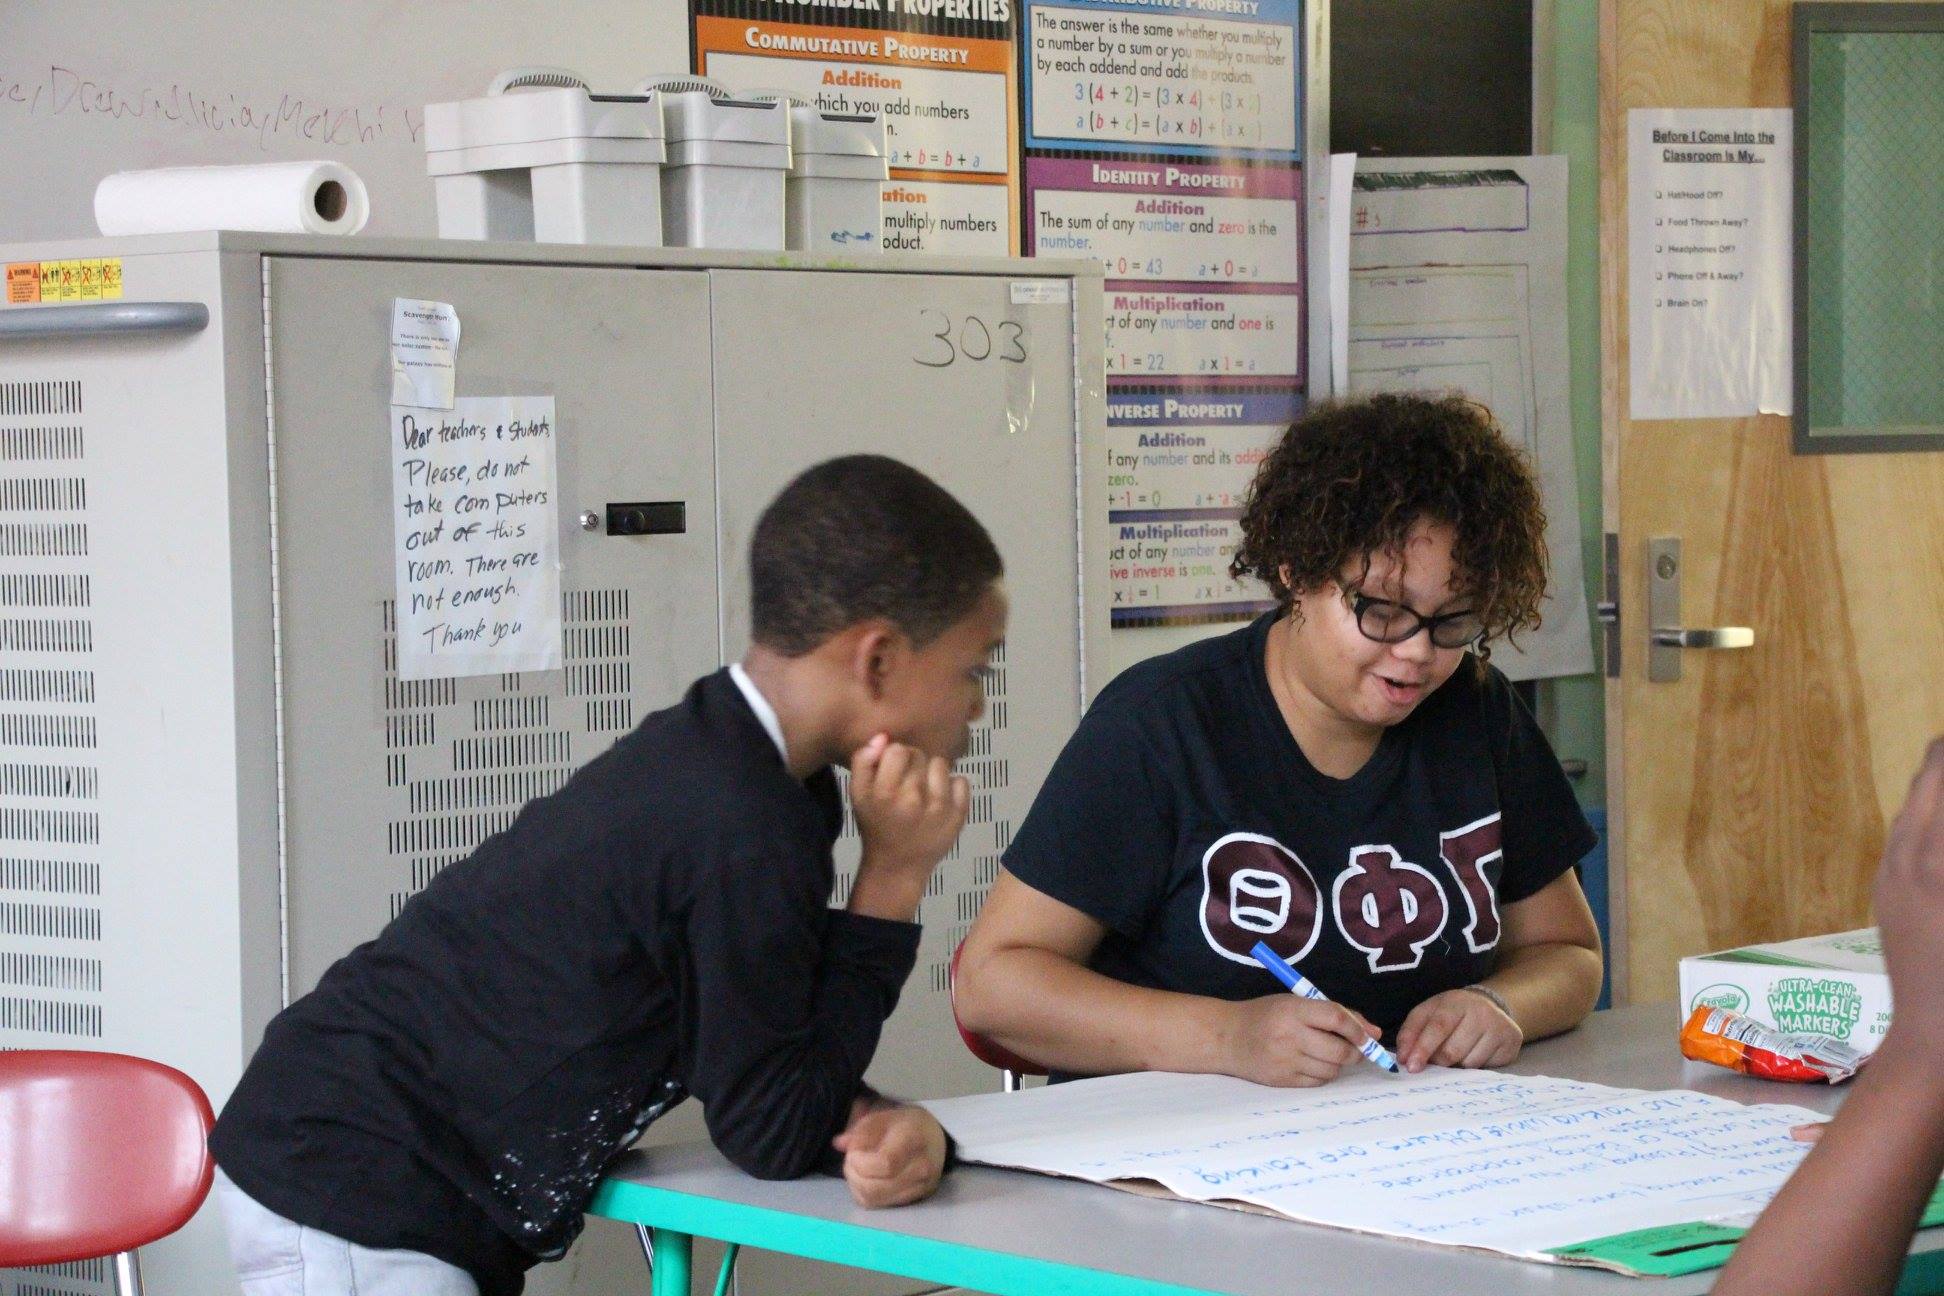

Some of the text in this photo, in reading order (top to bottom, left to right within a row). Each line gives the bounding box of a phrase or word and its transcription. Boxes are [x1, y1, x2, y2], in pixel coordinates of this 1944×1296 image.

[1036, 13, 1283, 49] The answer is the same whether you multiply
[745, 27, 970, 64] COMMUTATIVE PROPERTY
[1037, 38, 1045, 49] a
[1048, 36, 1095, 53] number
[1098, 38, 1112, 56] by
[1118, 43, 1125, 54] a
[1130, 44, 1151, 56] sum
[1155, 45, 1167, 57] or
[1171, 47, 1191, 62] you
[822, 69, 901, 90] Addition
[1037, 58, 1051, 75] by
[1055, 58, 1085, 74] each
[1090, 59, 1137, 77] addend
[1141, 61, 1161, 78] and
[1166, 62, 1188, 79] add
[814, 91, 970, 120] hich you add numbers
[1653, 130, 1688, 143] Before
[1699, 131, 1729, 143] Come
[1734, 131, 1754, 143] Into
[1758, 132, 1775, 143] the
[1663, 149, 1721, 162] Classroom
[1092, 164, 1246, 191] IDENTITY PROPERTY
[1135, 200, 1204, 216] Addition
[885, 211, 997, 233] multiply numbers
[1040, 212, 1277, 236] The sum of any number and zero is the
[881, 234, 923, 251] oduct.
[1040, 234, 1092, 250] number.
[1114, 296, 1224, 314] Multiplication
[1119, 312, 1131, 329] of
[1135, 318, 1157, 334] any
[1161, 313, 1206, 330] number
[1211, 313, 1235, 331] and
[1239, 318, 1261, 331] one
[1266, 315, 1275, 331] is
[913, 308, 1027, 367] 303
[1105, 399, 1244, 419] NVERSE PROPERTY
[402, 415, 434, 450] Dear
[438, 417, 486, 444] teachers
[1138, 432, 1206, 448] Addition
[402, 455, 531, 486] Please, do not
[1116, 454, 1139, 470] any
[1143, 449, 1188, 466] number
[1193, 449, 1215, 465] and
[1219, 450, 1231, 465] its
[404, 493, 442, 518] take
[405, 519, 527, 550] out of this
[1120, 523, 1228, 542] Multiplication
[1129, 542, 1142, 559] of
[1146, 547, 1168, 562] any
[1172, 542, 1215, 557] number
[408, 552, 540, 583] room. There are
[1133, 563, 1175, 578] inverse
[1179, 562, 1187, 576] is
[412, 576, 520, 615] not enough.
[423, 618, 522, 654] Thank you
[1779, 977, 1855, 998] ULTRA-CLEAN
[1768, 992, 1861, 1022] WASHABLE
[1779, 1013, 1850, 1039] MARKERS
